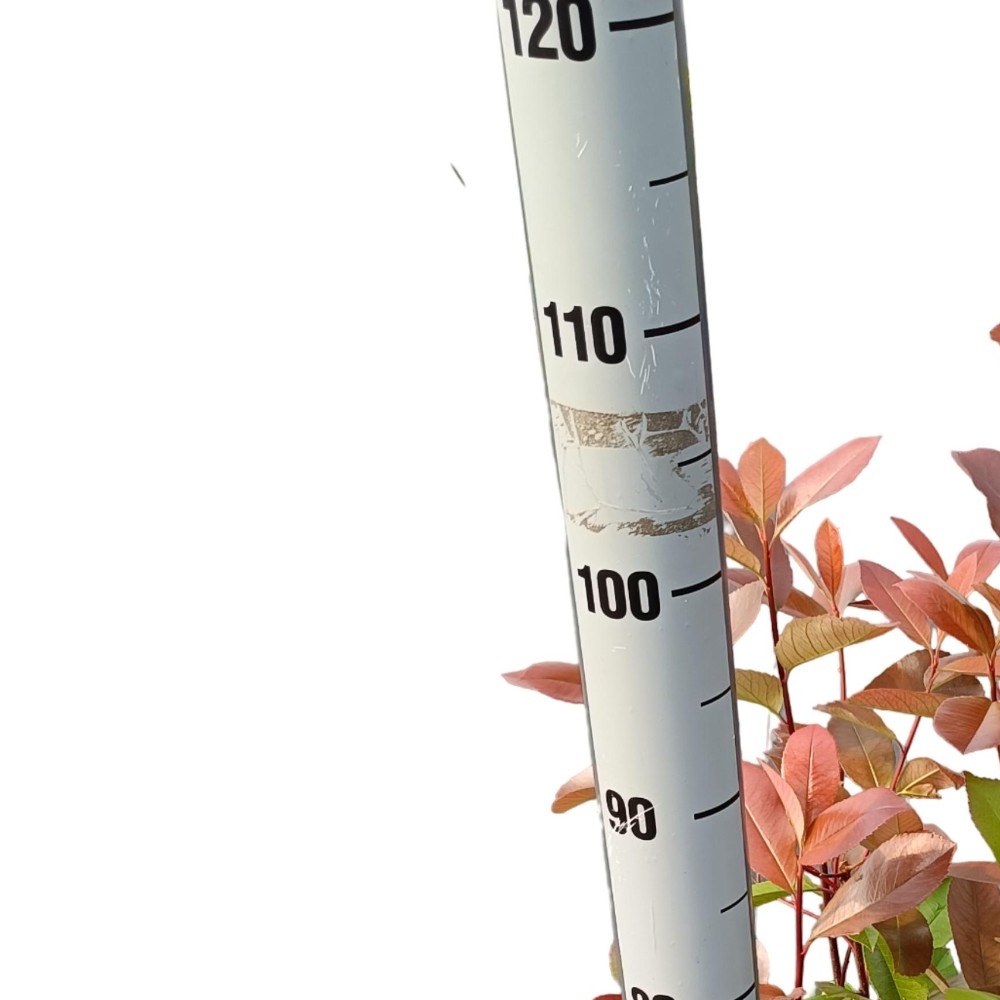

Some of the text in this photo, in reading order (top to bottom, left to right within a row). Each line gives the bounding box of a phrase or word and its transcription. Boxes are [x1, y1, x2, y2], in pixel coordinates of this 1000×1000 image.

[503, 0, 597, 61] 120
[543, 301, 627, 364] 110
[577, 564, 661, 621] 100
[606, 789, 657, 841] 90
